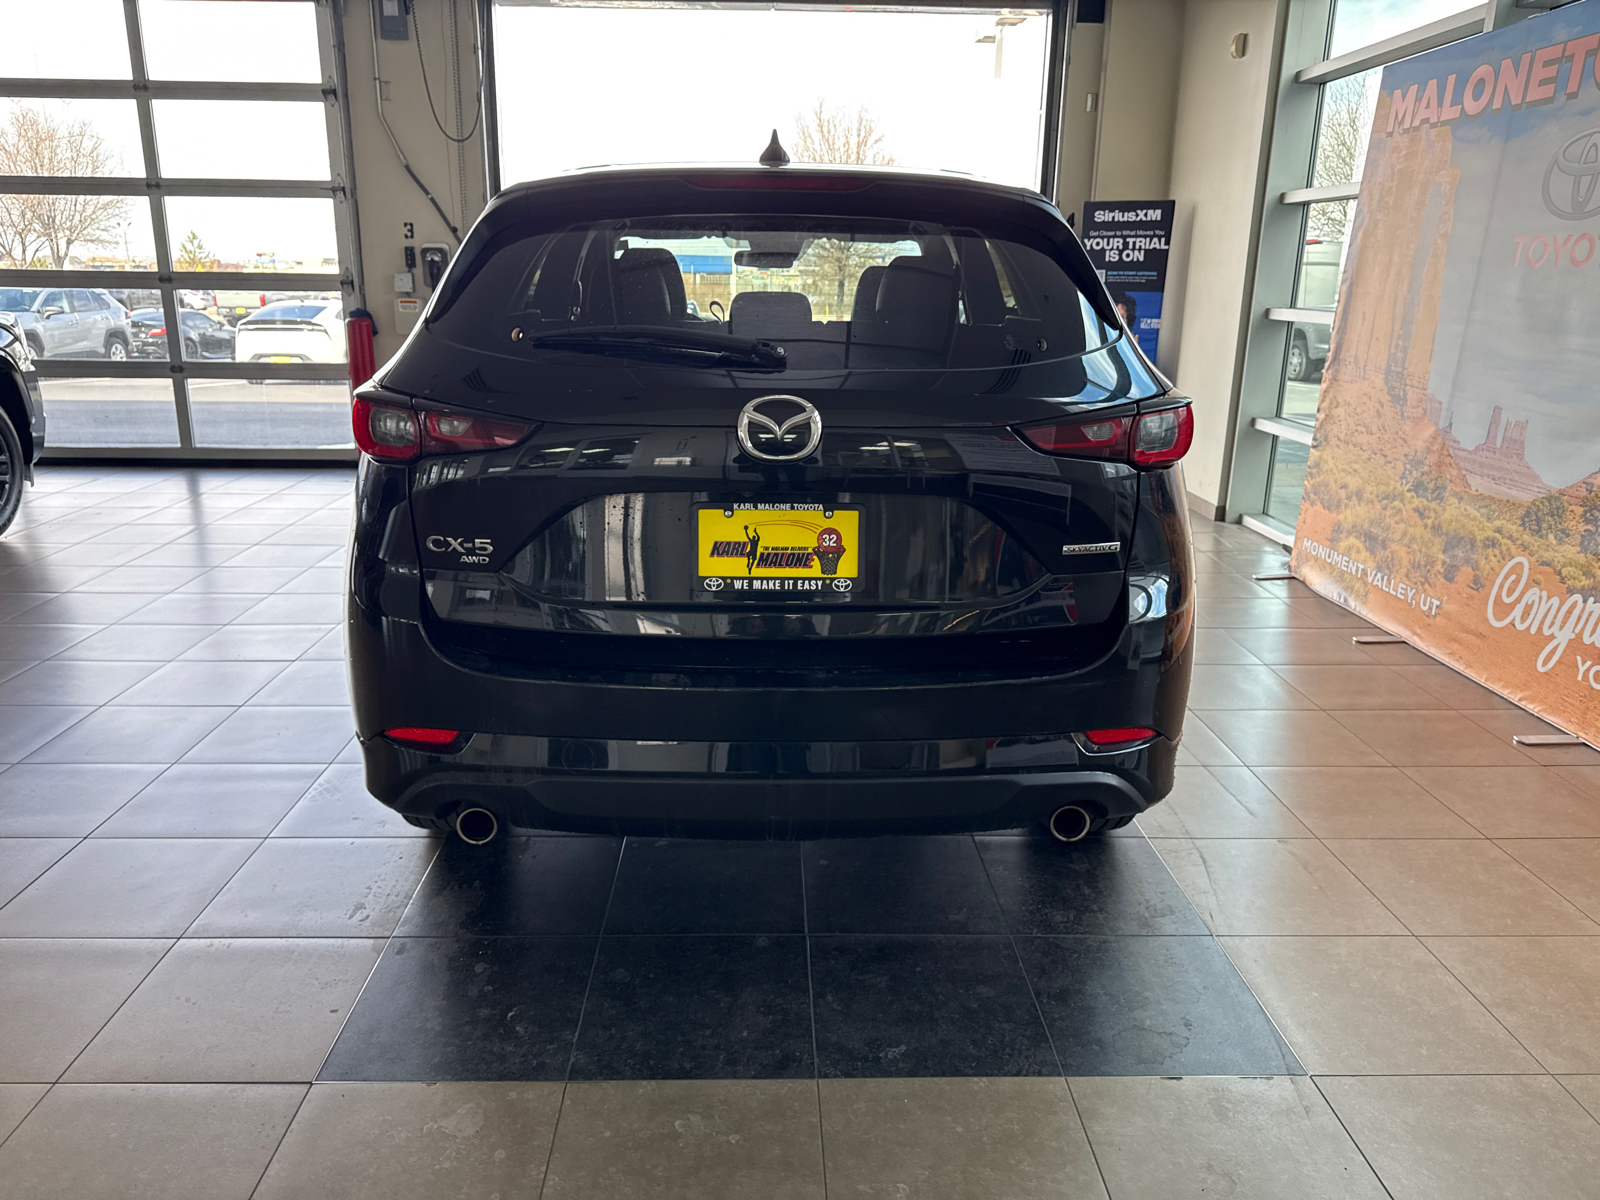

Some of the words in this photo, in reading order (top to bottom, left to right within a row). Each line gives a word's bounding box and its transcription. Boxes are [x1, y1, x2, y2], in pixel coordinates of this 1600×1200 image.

[1386, 33, 1600, 137] MALONET
[1094, 209, 1162, 222] SiriusXM
[403, 222, 414, 239] 3
[1083, 238, 1123, 250] YOUR
[1126, 237, 1169, 250] TRIAL
[1512, 232, 1600, 268] TOYO
[1105, 250, 1119, 262] IS
[1122, 250, 1144, 262] ON
[733, 503, 756, 511] KARL
[757, 503, 792, 511] MALONE
[793, 503, 824, 511] TOYOTA
[426, 535, 494, 554] CX-5
[822, 534, 837, 547] 32
[709, 541, 750, 557] KARL
[459, 555, 490, 564] AWD
[755, 552, 815, 569] MALONE
[1302, 537, 1364, 578] MONUMENT
[1367, 567, 1416, 608] VALLEY,
[1419, 593, 1441, 616] UT
[733, 580, 749, 590] WE
[753, 580, 781, 590] MAKE
[785, 580, 794, 590] IT
[797, 580, 823, 590] EASY
[1487, 556, 1600, 672] Congr
